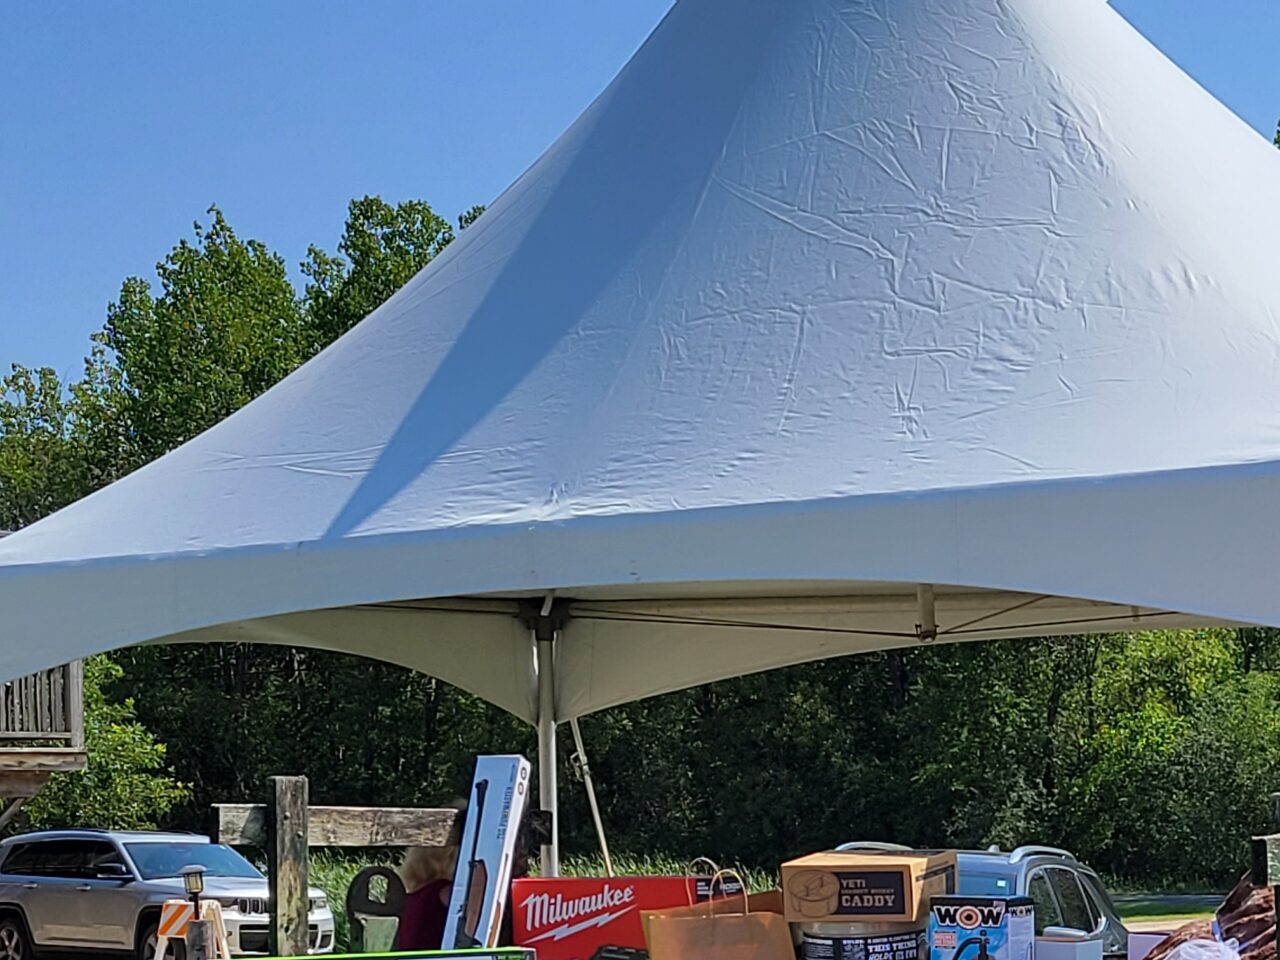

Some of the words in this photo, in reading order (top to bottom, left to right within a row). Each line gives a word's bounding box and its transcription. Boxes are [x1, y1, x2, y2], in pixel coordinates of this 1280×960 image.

[841, 879, 866, 888] YETI
[520, 884, 635, 931] Milwaukee
[841, 895, 895, 907] CADDY
[933, 905, 1006, 929] WOW
